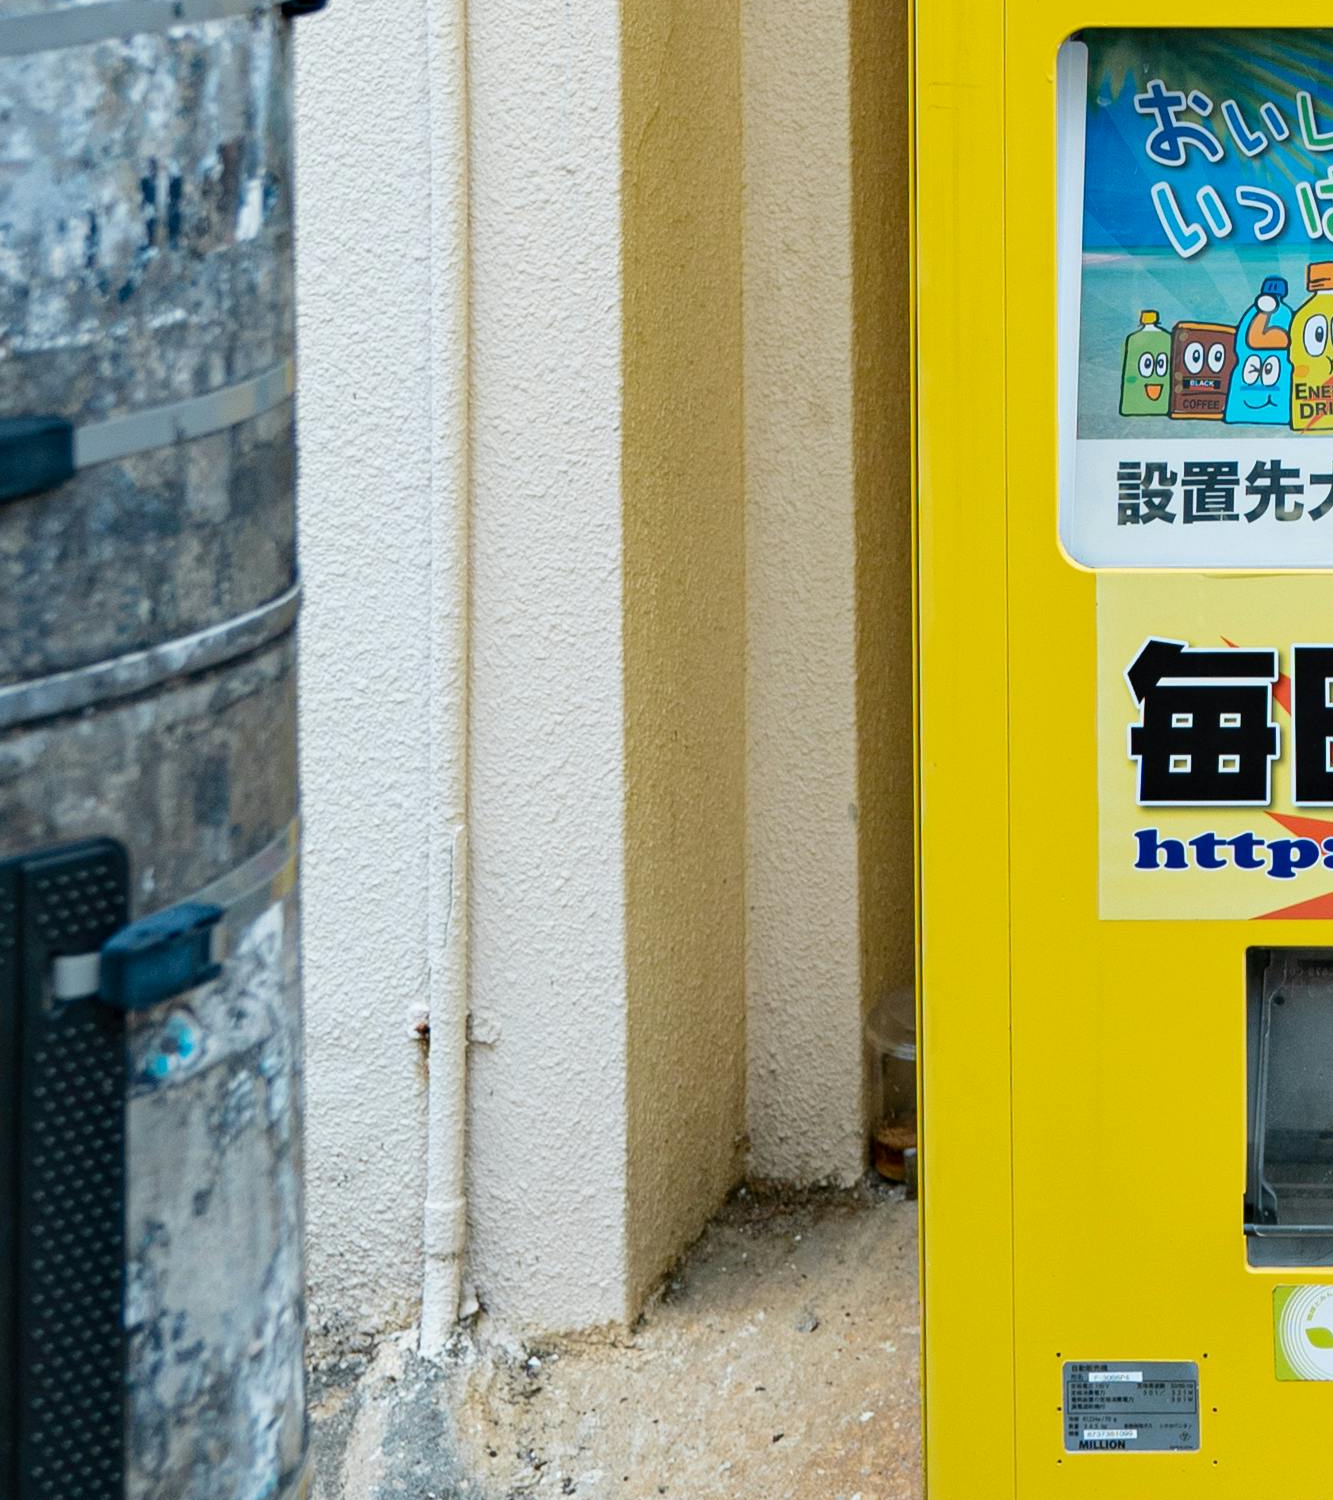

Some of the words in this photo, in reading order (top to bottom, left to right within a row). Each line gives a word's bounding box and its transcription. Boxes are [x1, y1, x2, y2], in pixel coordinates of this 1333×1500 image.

[1190, 379, 1215, 388] BLACK
[1182, 399, 1220, 411] COFFEE
[1079, 1440, 1125, 1449] MILLION
